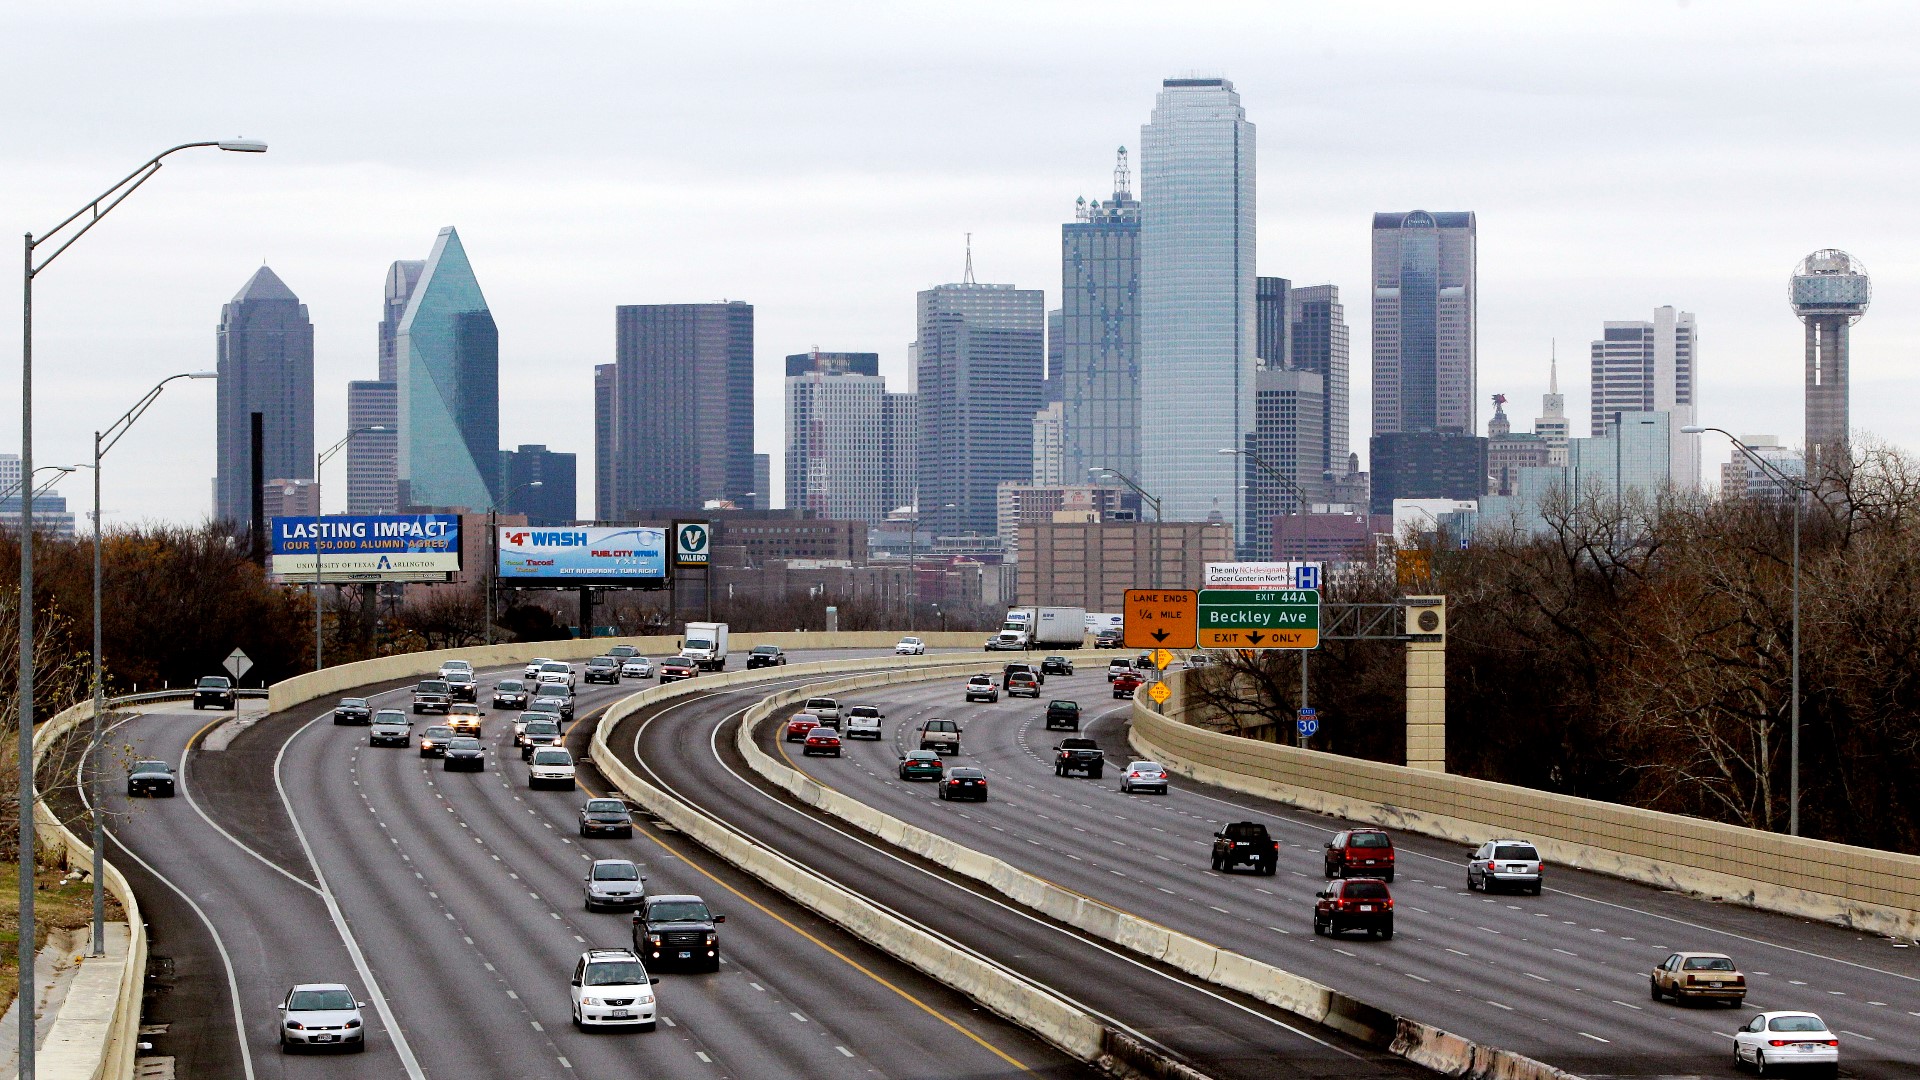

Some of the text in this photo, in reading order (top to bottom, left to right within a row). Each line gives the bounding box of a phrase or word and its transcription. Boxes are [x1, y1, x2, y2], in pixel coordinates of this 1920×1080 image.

[282, 521, 448, 538] LASTING IMPACT
[531, 532, 587, 546] WASH
[283, 540, 449, 551] (OUR 150,000 ALUMNI AGREE)
[680, 554, 707, 562] VALERO
[1210, 566, 1223, 574] The
[1224, 566, 1239, 574] only
[1265, 574, 1285, 582] North
[1255, 592, 1307, 603] EXIT 44A
[1160, 611, 1182, 619] MILE
[1210, 611, 1307, 626] Beckley Ave
[1214, 633, 1302, 643] EXIT ONLY
[1299, 720, 1316, 732] 30
